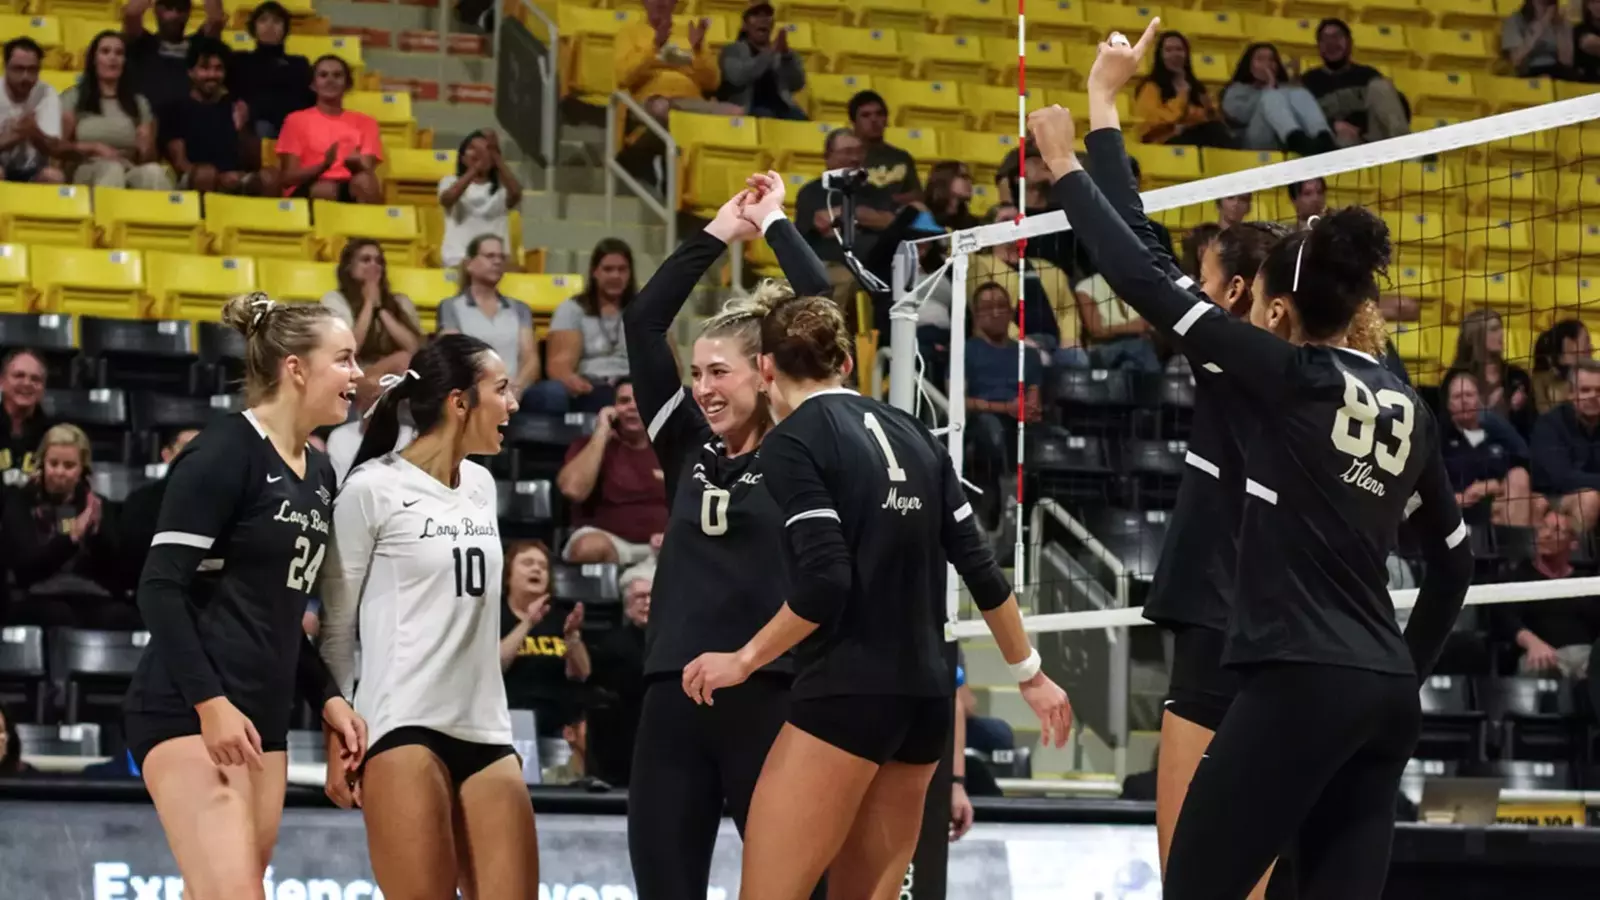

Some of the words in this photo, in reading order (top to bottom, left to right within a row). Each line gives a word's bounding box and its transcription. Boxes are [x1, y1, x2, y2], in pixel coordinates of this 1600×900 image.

[1331, 370, 1414, 476] 83
[864, 412, 907, 482] 1
[1340, 458, 1386, 497] Glenn
[273, 499, 310, 531] Long
[701, 489, 731, 536] 0
[881, 487, 922, 516] Meyer
[420, 517, 460, 541] Long
[461, 517, 497, 537] Beach
[286, 535, 326, 594] 24
[452, 546, 486, 597] 10
